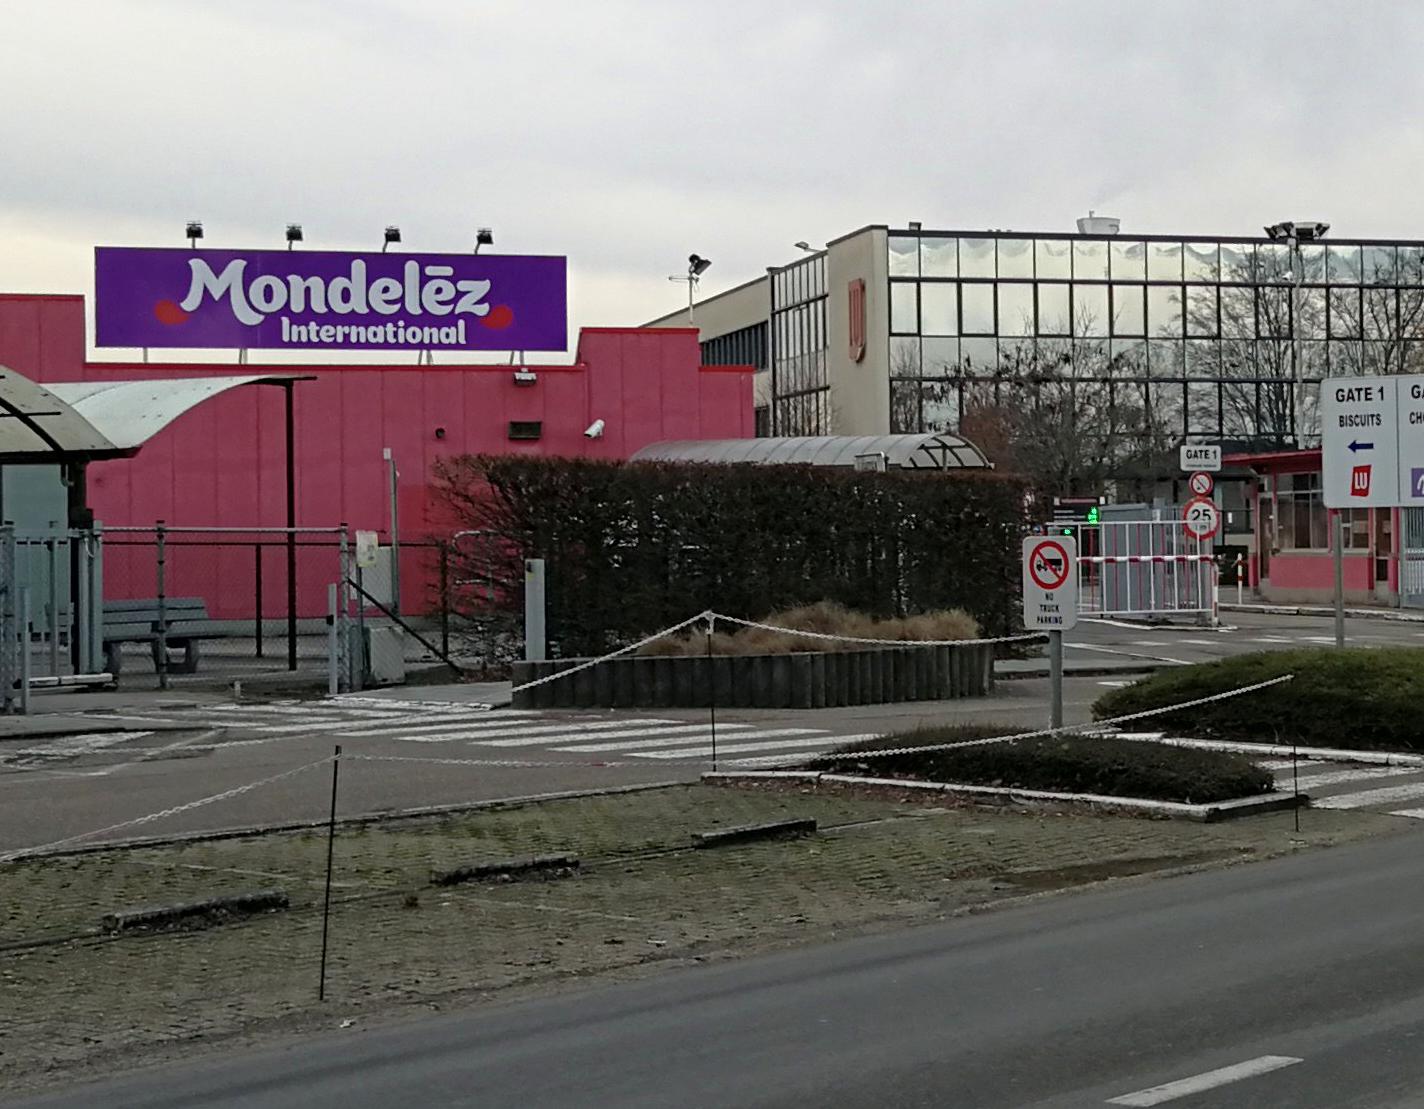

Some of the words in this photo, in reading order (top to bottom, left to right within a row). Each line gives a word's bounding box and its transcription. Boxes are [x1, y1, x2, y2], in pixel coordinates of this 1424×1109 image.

[180, 258, 491, 326] Mondelēz
[281, 317, 467, 345] International
[1336, 387, 1373, 402] GATE
[1378, 386, 1385, 400] 1
[1338, 413, 1382, 427] BISCUITS
[1186, 449, 1210, 460] GATE
[1212, 449, 1217, 460] 1
[1354, 471, 1369, 490] LU
[1191, 508, 1211, 521] 25
[1045, 592, 1054, 601] NO
[1037, 616, 1063, 624] PARKING
